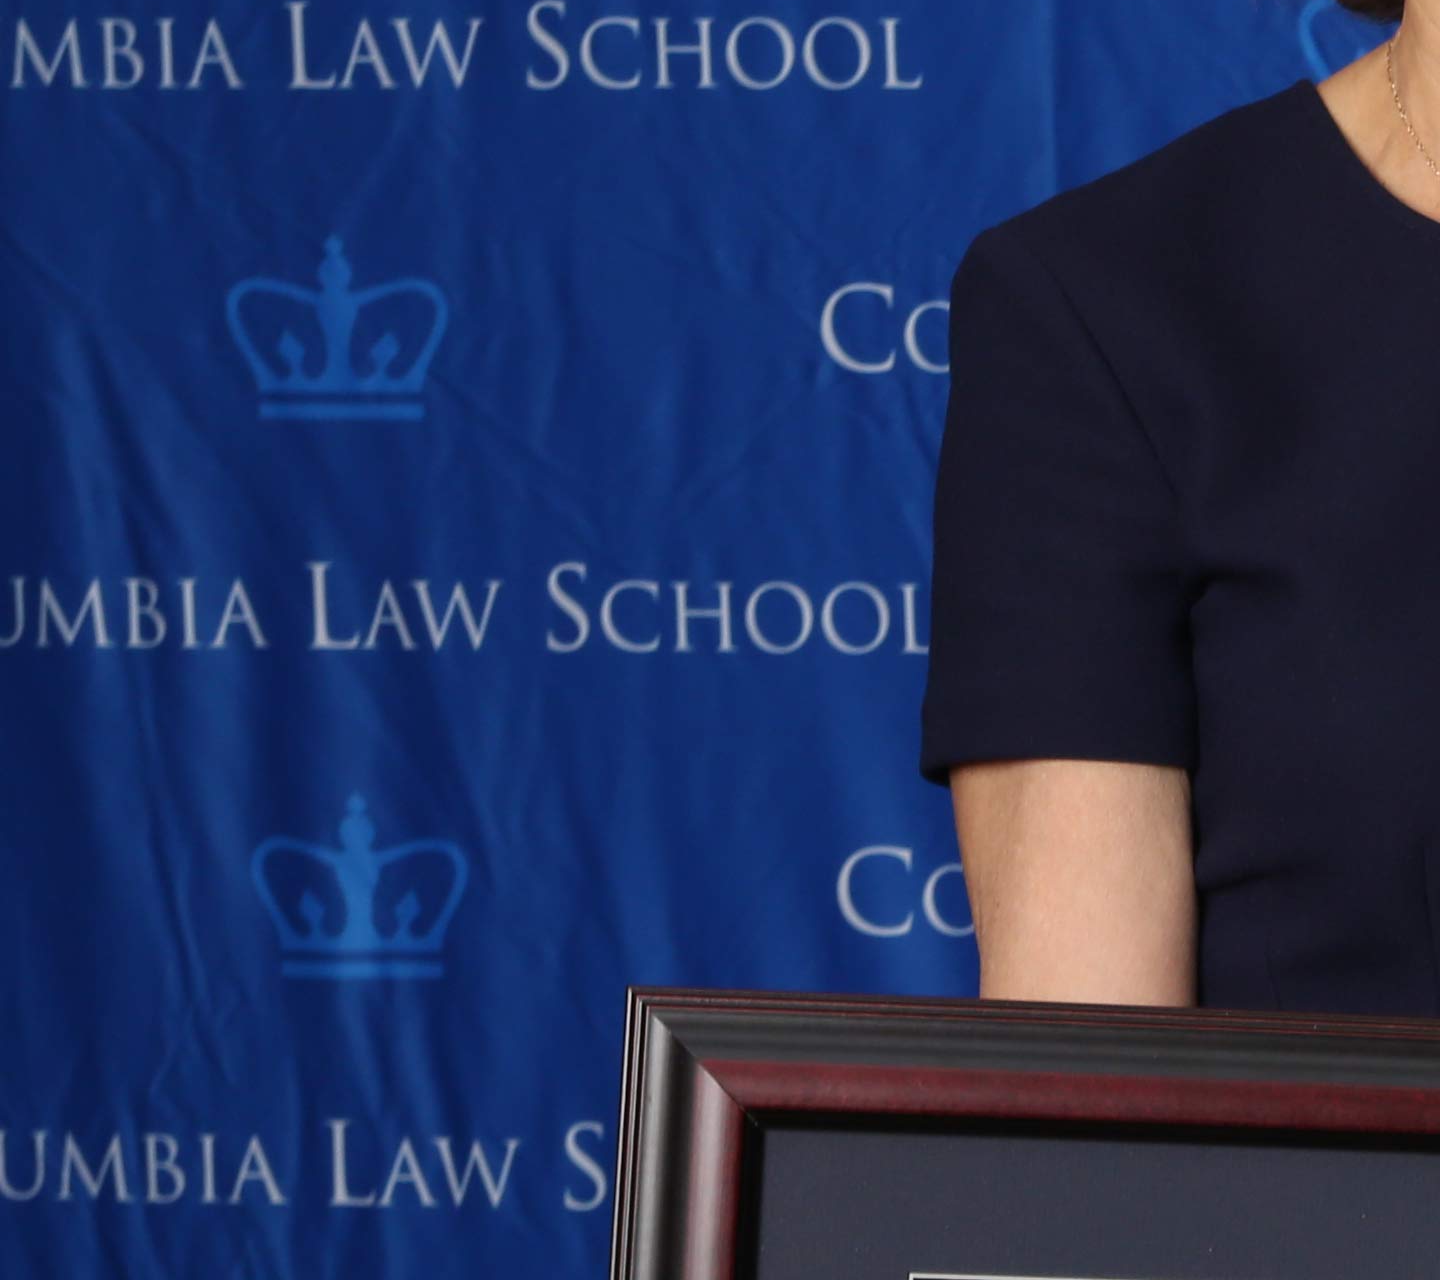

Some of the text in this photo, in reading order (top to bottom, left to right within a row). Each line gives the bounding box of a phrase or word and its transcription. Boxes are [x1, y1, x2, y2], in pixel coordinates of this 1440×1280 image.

[286, 0, 483, 91] LAW
[308, 560, 501, 651] LAW
[545, 560, 931, 655] SCHOOL
[328, 1117, 520, 1208] LAW
